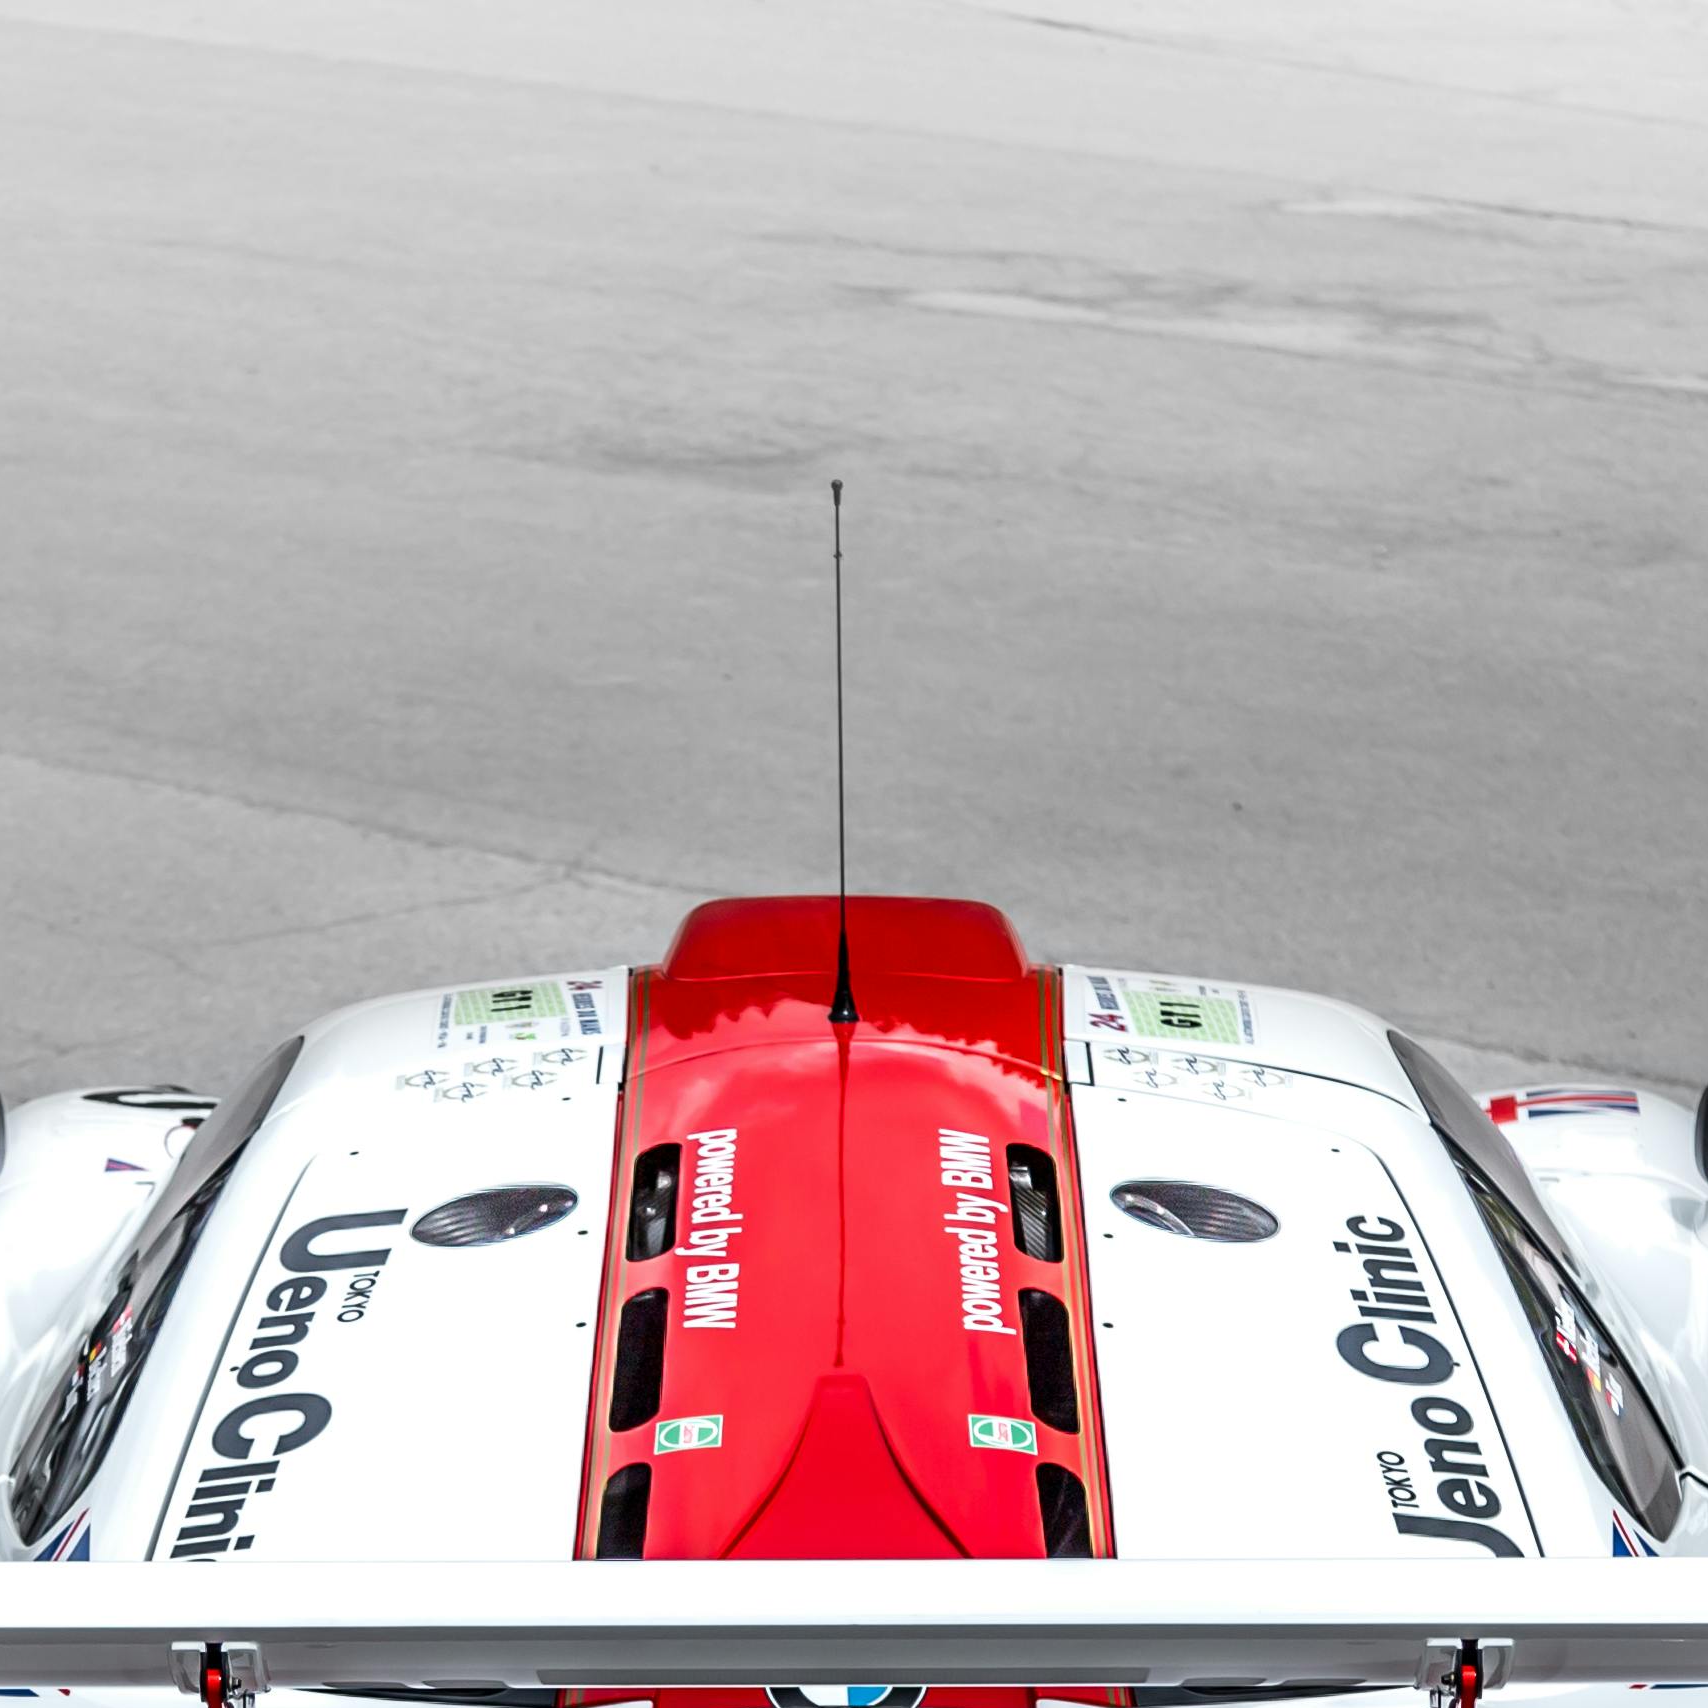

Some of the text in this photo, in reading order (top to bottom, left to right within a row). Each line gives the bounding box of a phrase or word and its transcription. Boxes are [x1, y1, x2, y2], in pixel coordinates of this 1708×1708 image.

[1088, 1012, 1128, 1032] 24
[337, 1270, 380, 1323] TOKYO
[675, 1128, 743, 1329] powered by BMW
[938, 1129, 1017, 1335] powered by BMW
[1333, 1215, 1455, 1386] Clinic
[170, 1208, 408, 1562] Ueno Clini
[1376, 1451, 1420, 1508] TOKYO
